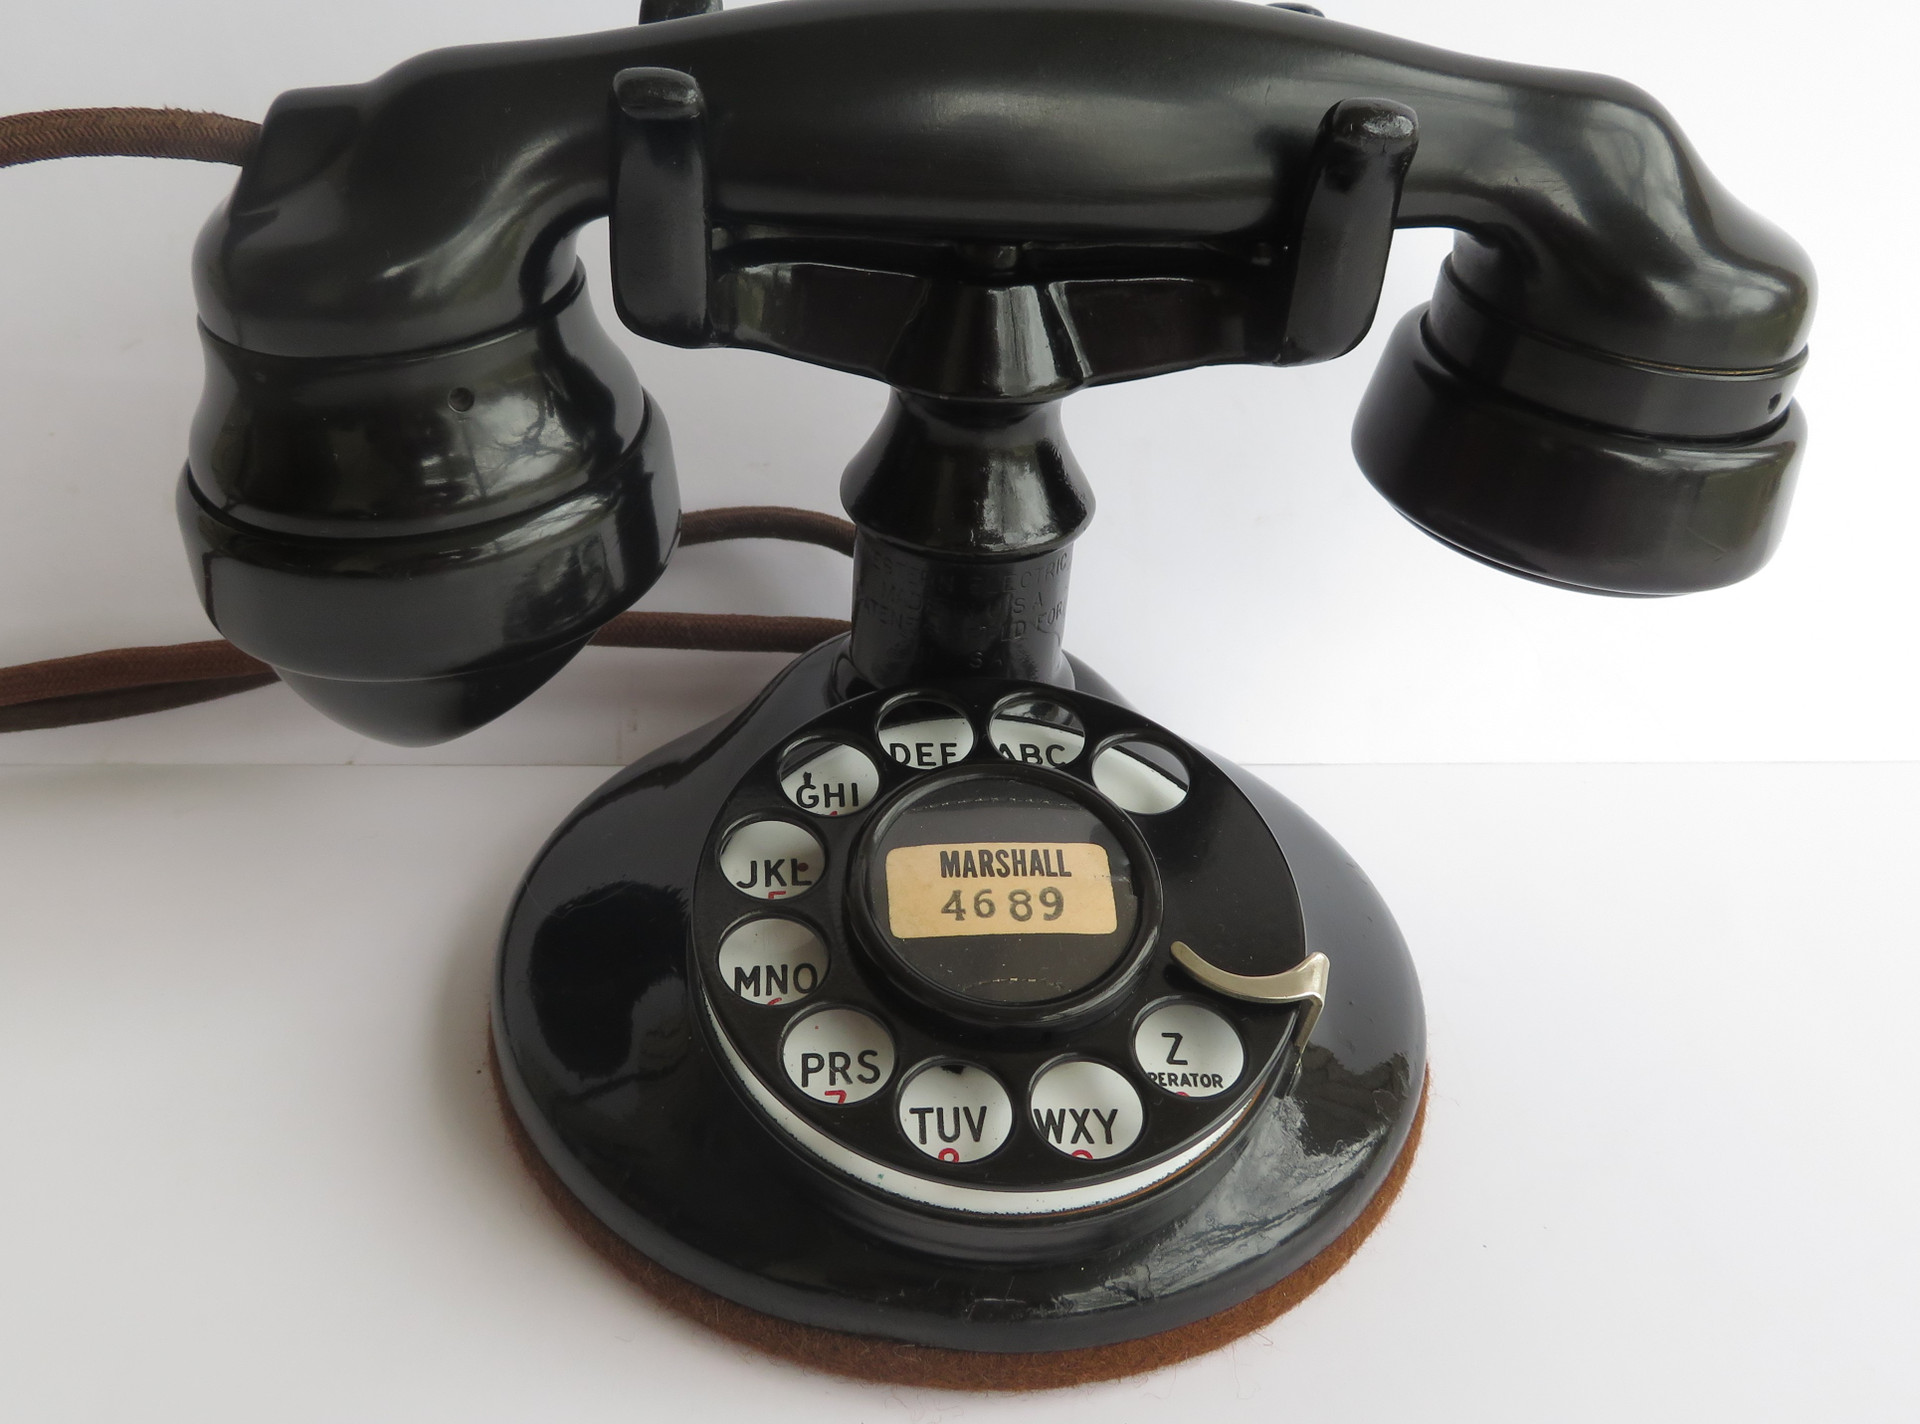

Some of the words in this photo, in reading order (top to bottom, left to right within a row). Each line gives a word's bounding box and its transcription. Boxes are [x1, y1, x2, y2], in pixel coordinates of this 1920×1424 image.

[890, 743, 957, 767] DEF
[999, 743, 1066, 768] ABC
[796, 782, 860, 809] GHI
[736, 858, 813, 889] JKL
[939, 849, 1072, 878] MARSHALL
[941, 886, 1064, 922] 4689
[734, 962, 818, 998] MNO
[1161, 1032, 1189, 1066] Z
[801, 1049, 881, 1088] PRS
[1146, 1072, 1224, 1089] PERATOR
[909, 1105, 987, 1145] TUV
[1033, 1108, 1118, 1145] WXY
